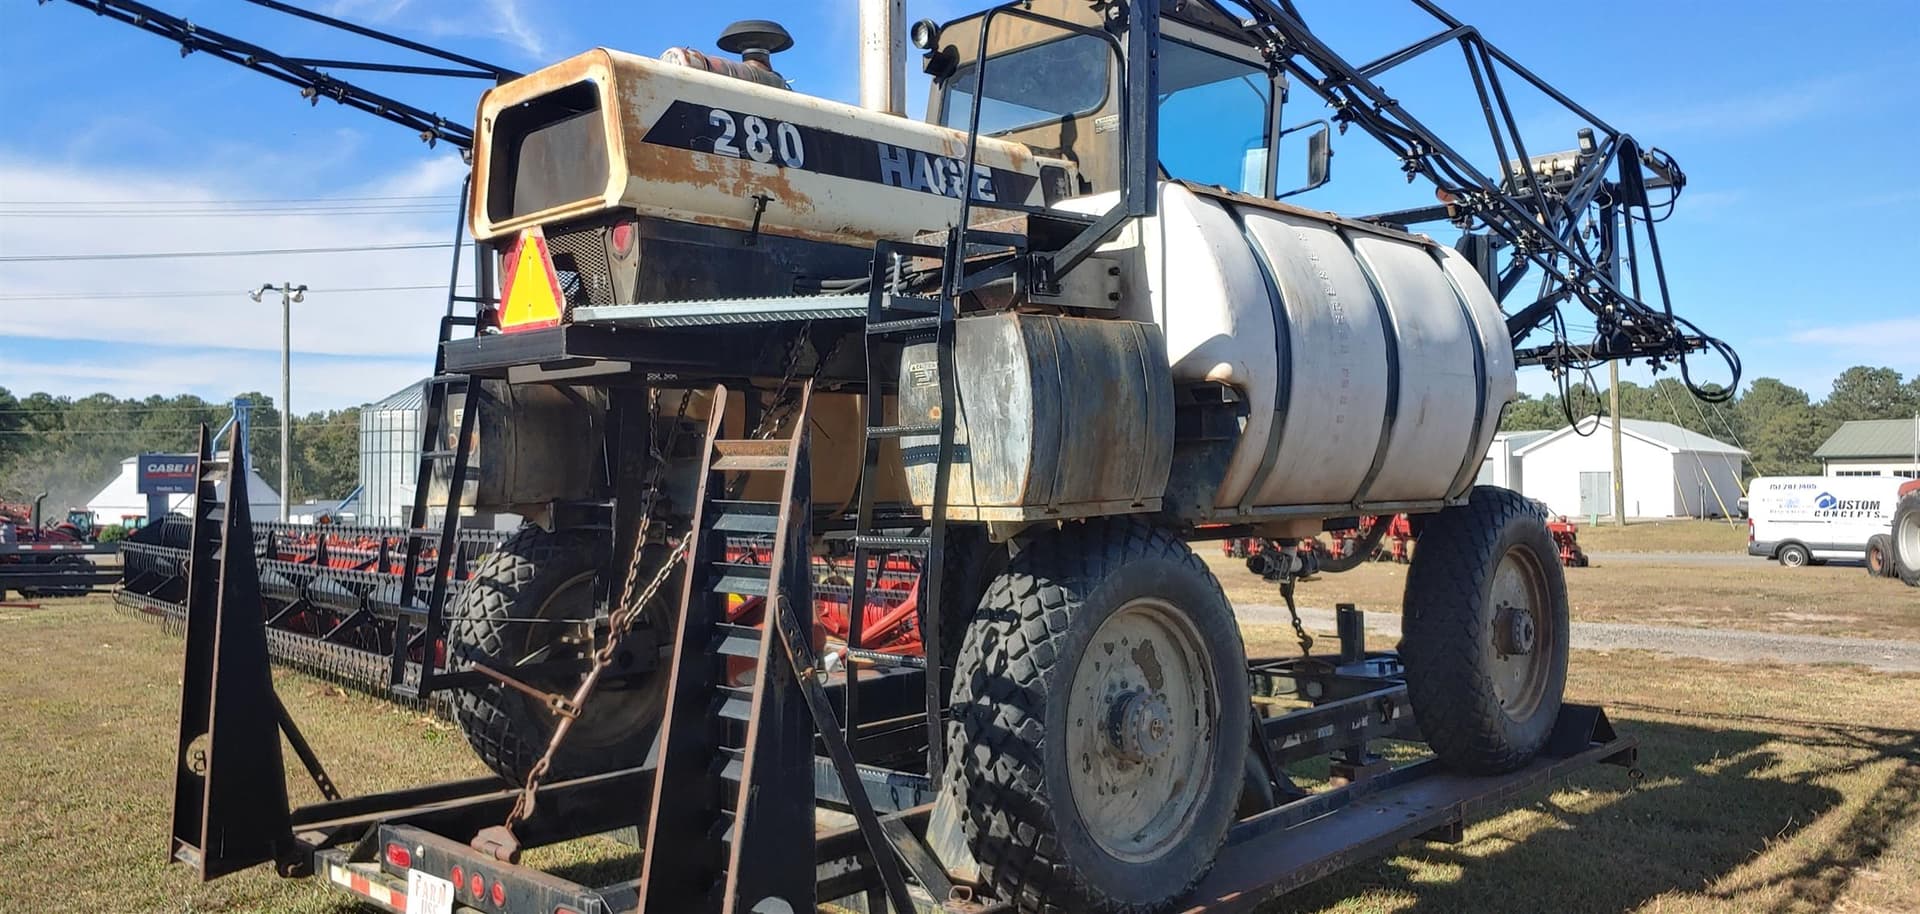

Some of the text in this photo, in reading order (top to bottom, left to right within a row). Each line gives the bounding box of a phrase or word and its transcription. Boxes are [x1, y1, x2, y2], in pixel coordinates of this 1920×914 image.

[709, 109, 805, 169] 280
[147, 463, 184, 473] CASE
[1814, 510, 1881, 519] CONCEPTS
